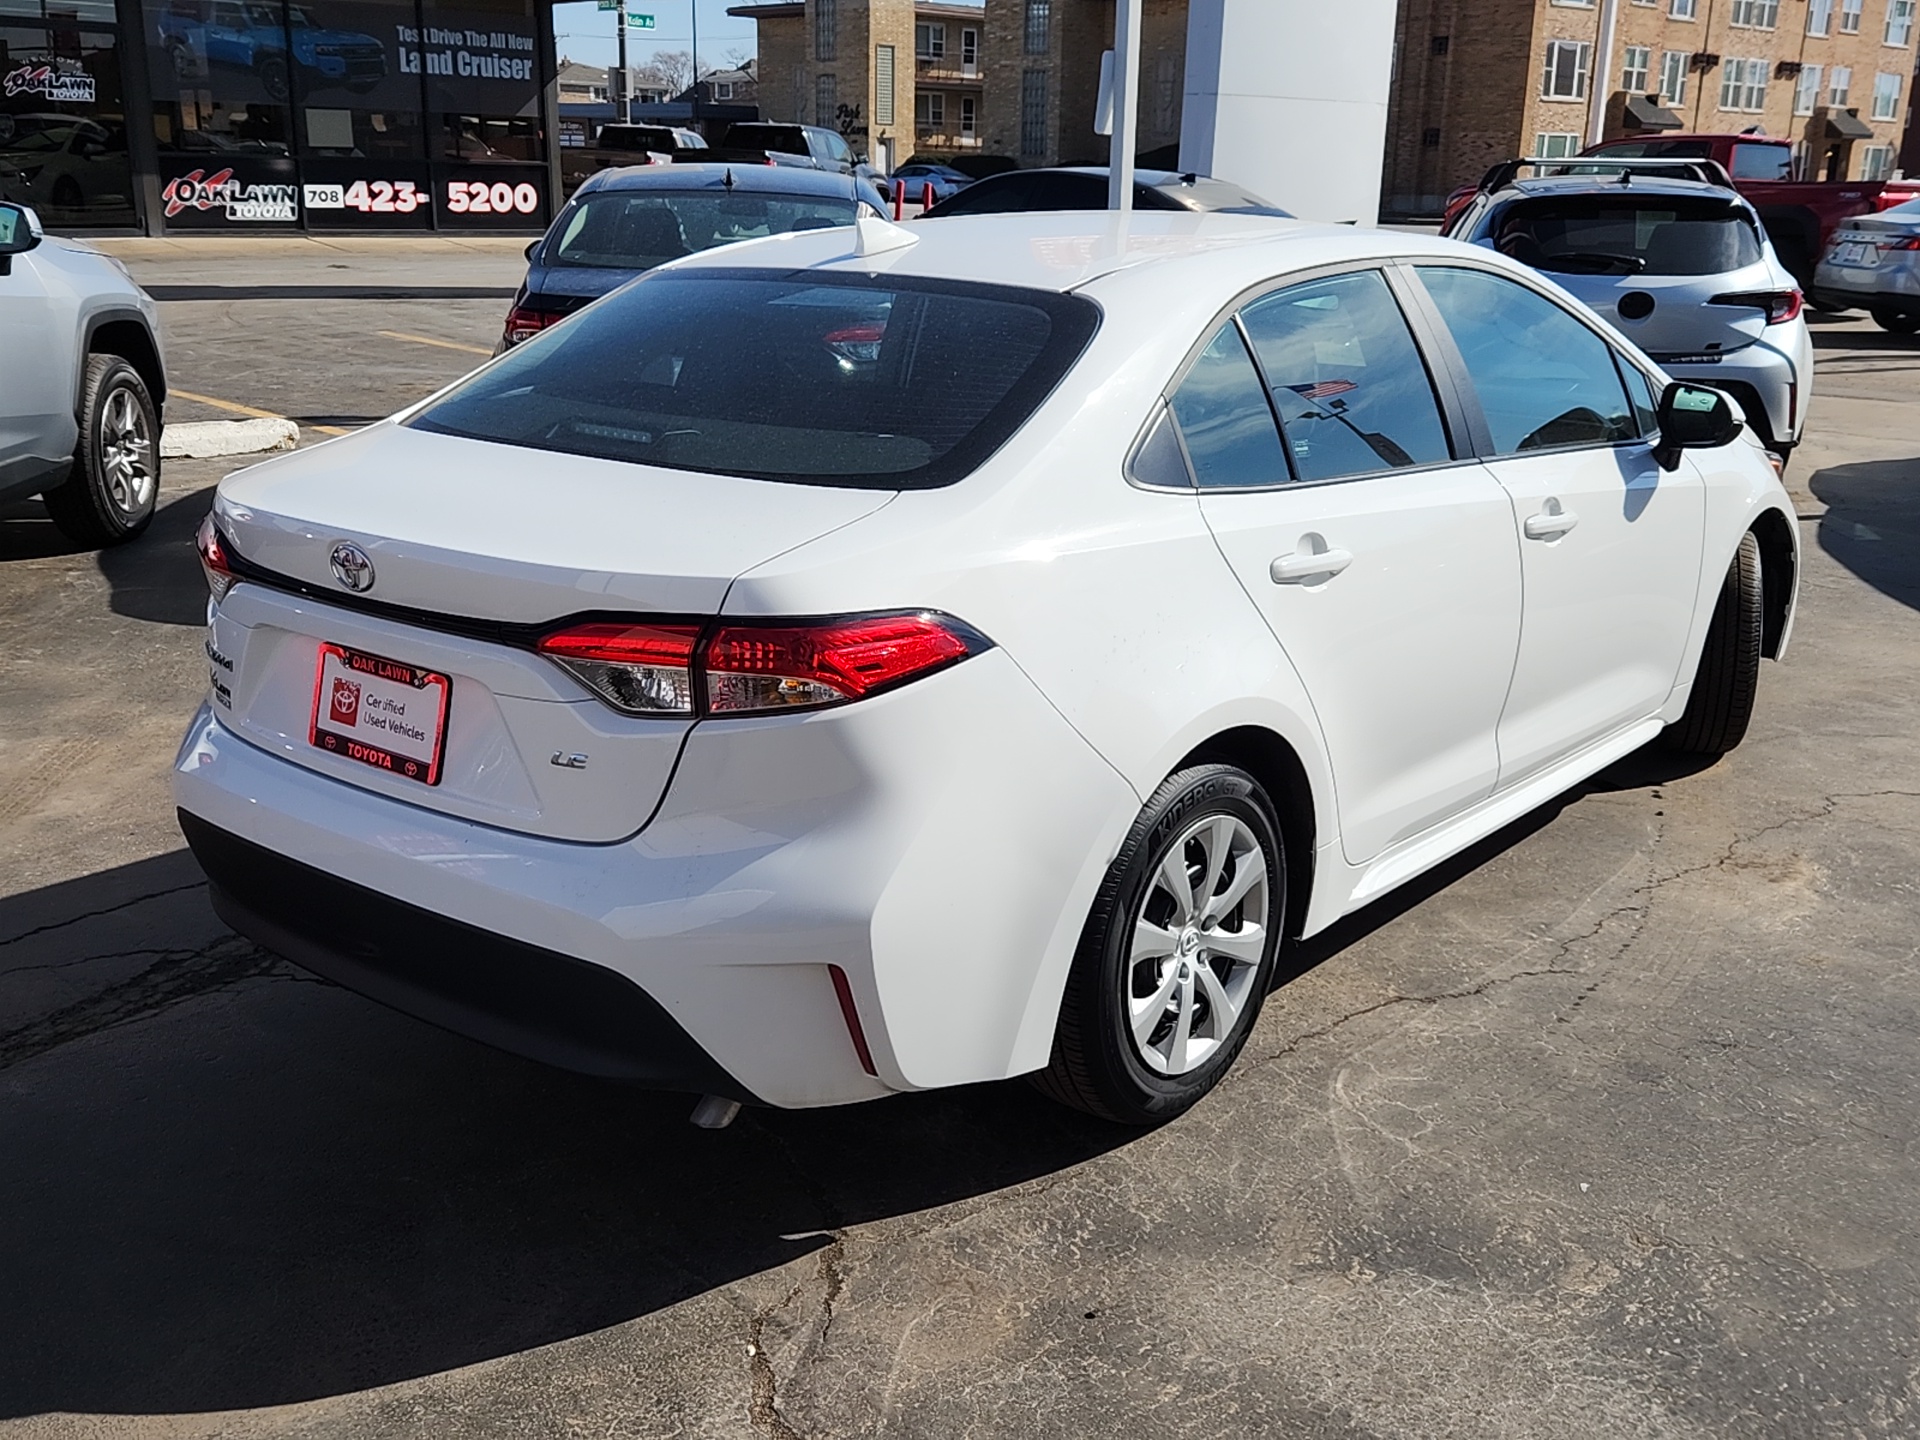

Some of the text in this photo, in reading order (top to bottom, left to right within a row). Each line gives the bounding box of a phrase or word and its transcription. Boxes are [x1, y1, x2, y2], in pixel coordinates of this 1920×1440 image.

[396, 25, 533, 51] Test Drive The All New
[398, 47, 533, 80] Land Cruiser
[53, 90, 91, 99] TOYOTA
[308, 190, 340, 203] 708
[447, 182, 538, 213] 5200
[233, 204, 293, 218] TOYOTA
[352, 655, 411, 683] OAK LAWN
[365, 693, 406, 716] Certified
[363, 711, 426, 742] Used Vehicles
[347, 742, 392, 769] TOYOTA
[550, 750, 589, 770] LE
